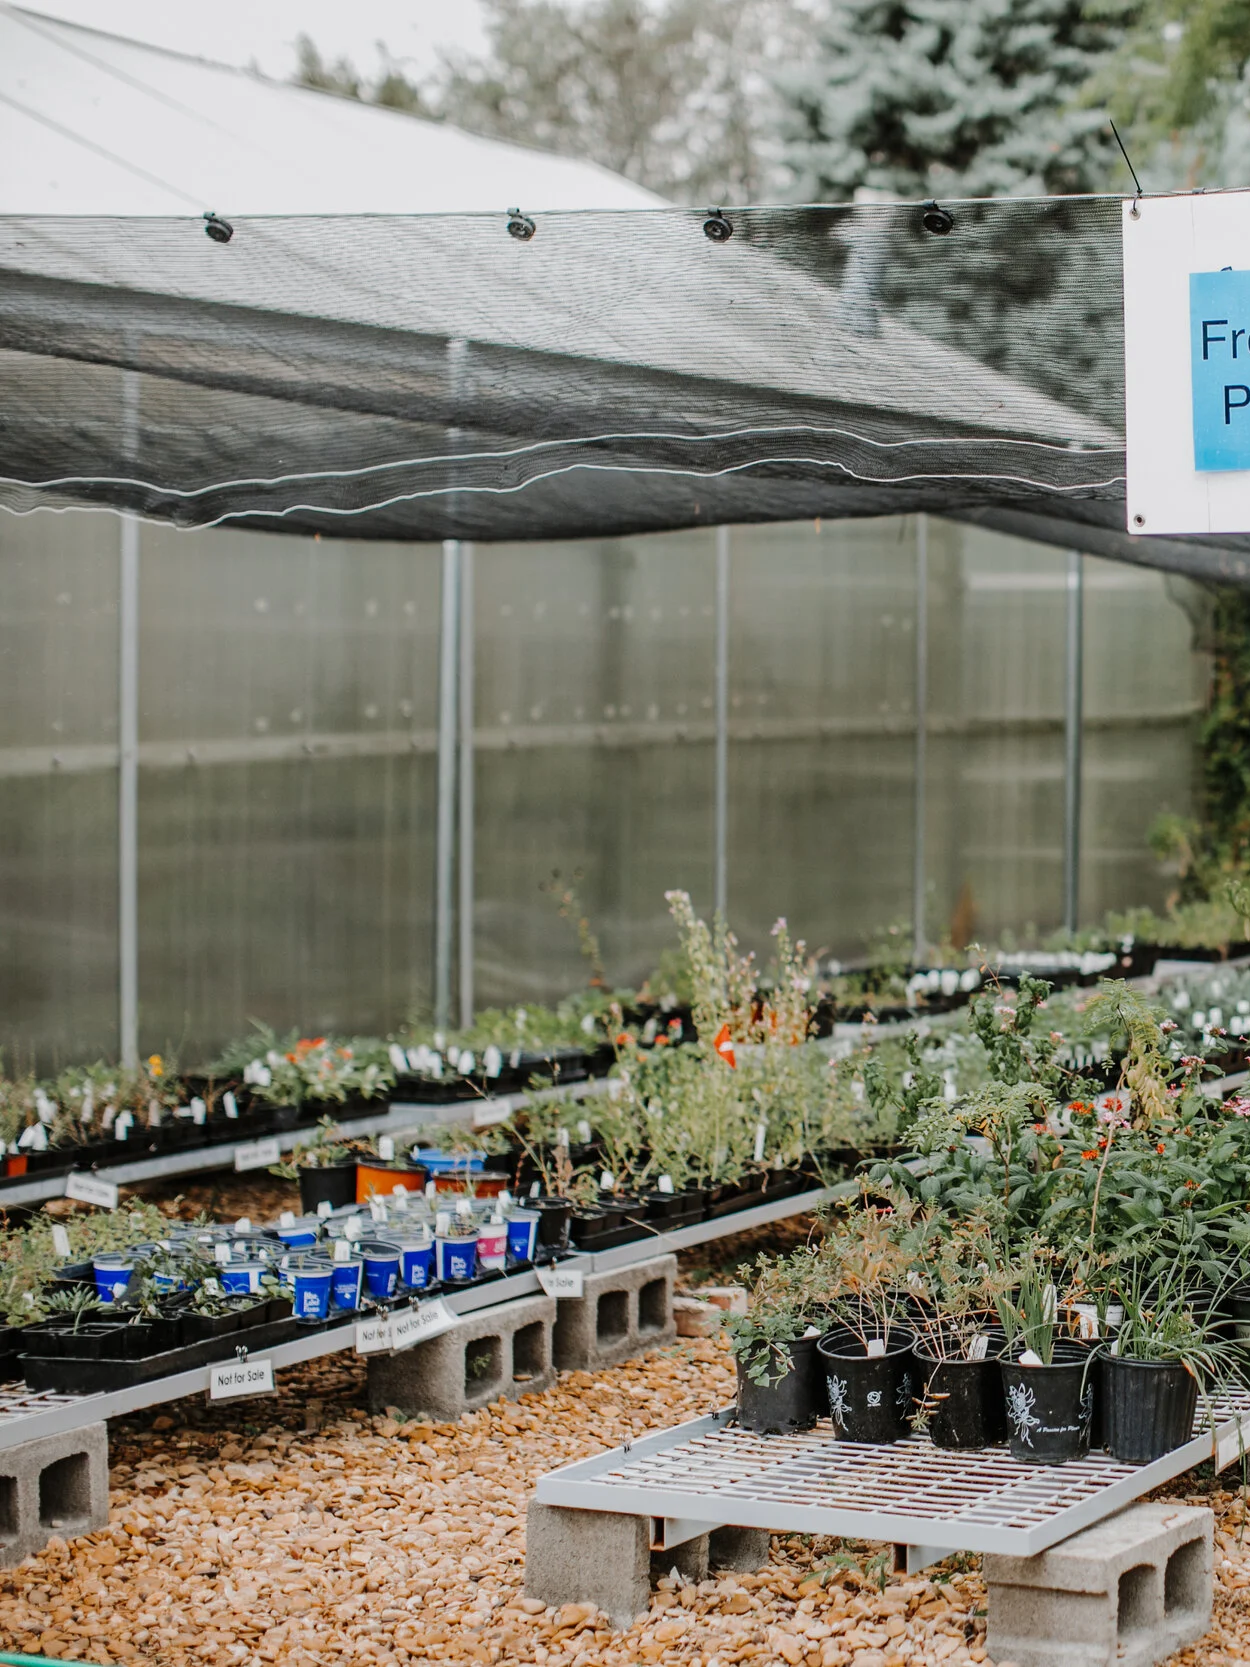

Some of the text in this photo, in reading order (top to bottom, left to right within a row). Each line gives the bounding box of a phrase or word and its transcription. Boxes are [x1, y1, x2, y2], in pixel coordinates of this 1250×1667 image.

[396, 1322, 409, 1336] Not
[410, 1319, 420, 1330] for
[421, 1311, 439, 1325] Sale
[362, 1330, 375, 1342] Not
[218, 1369, 265, 1386] Not for Sale
